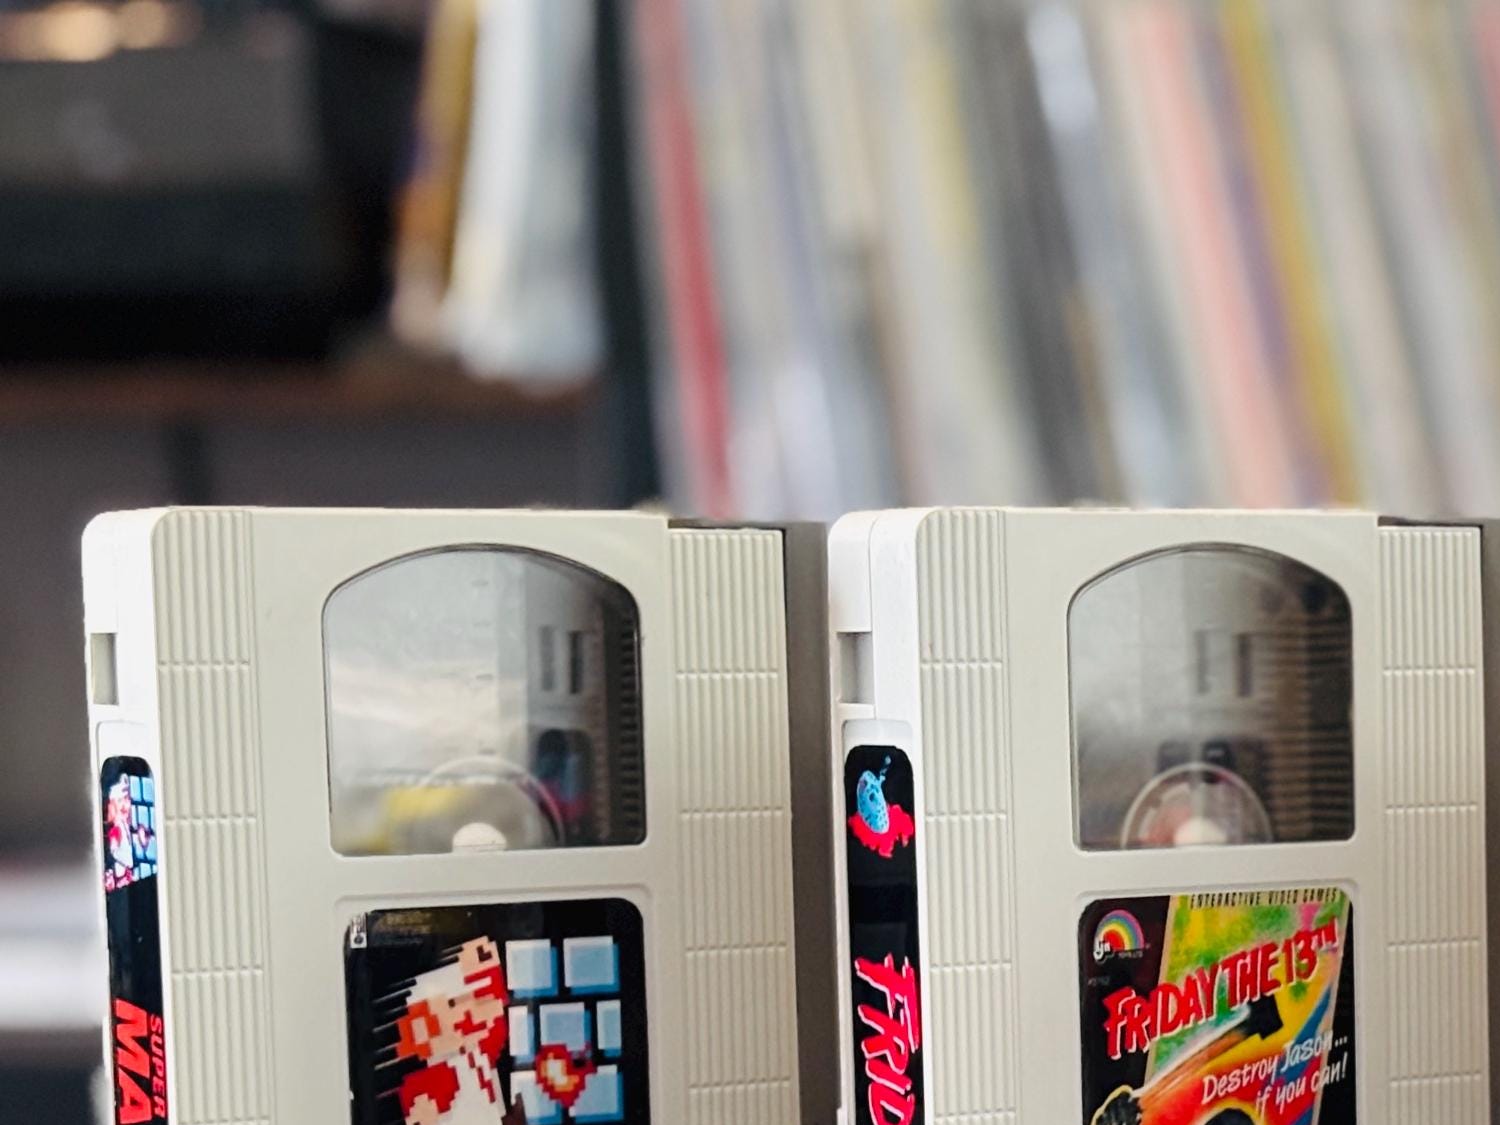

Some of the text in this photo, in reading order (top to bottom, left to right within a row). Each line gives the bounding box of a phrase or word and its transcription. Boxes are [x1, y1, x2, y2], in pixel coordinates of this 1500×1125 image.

[1303, 887, 1337, 902] GAMES
[1103, 963, 1220, 1060] FRIDAY
[1220, 941, 1281, 1012] THE
[150, 1013, 167, 1119] SUPER
[1201, 1054, 1279, 1105] Destroy
[1256, 1052, 1348, 1119] if you can!
